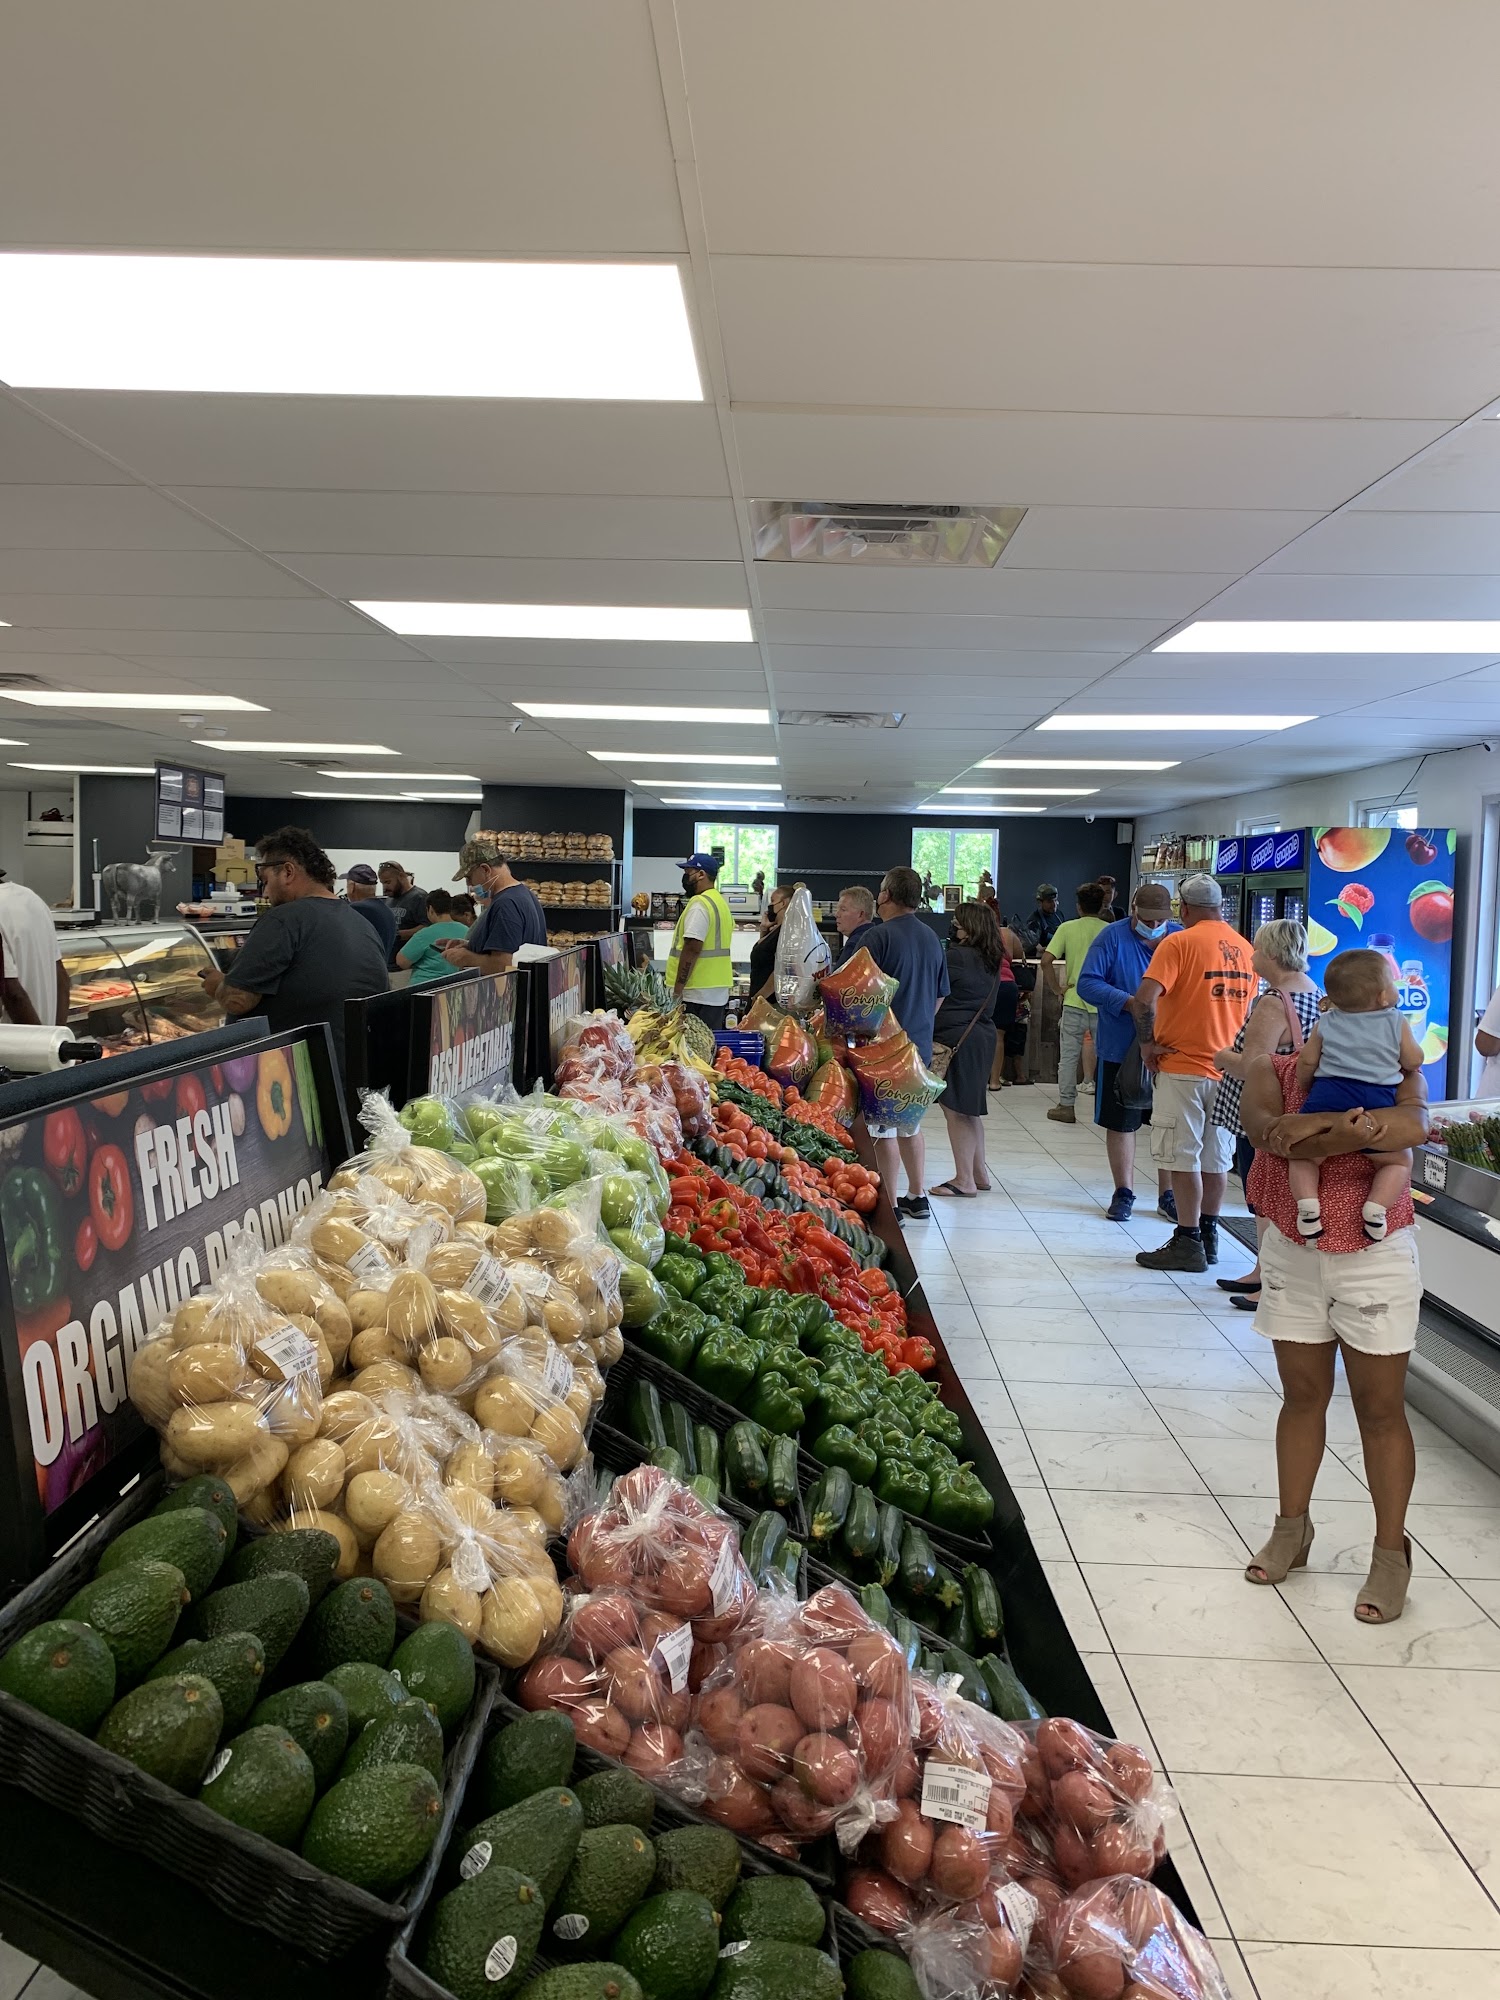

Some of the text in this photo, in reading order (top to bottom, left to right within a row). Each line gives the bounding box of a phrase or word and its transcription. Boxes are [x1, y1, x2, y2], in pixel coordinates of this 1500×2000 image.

[431, 1021, 513, 1100] RESH VEGETABLES
[874, 1079, 938, 1113] Congrats!
[136, 1102, 240, 1232] FRESH
